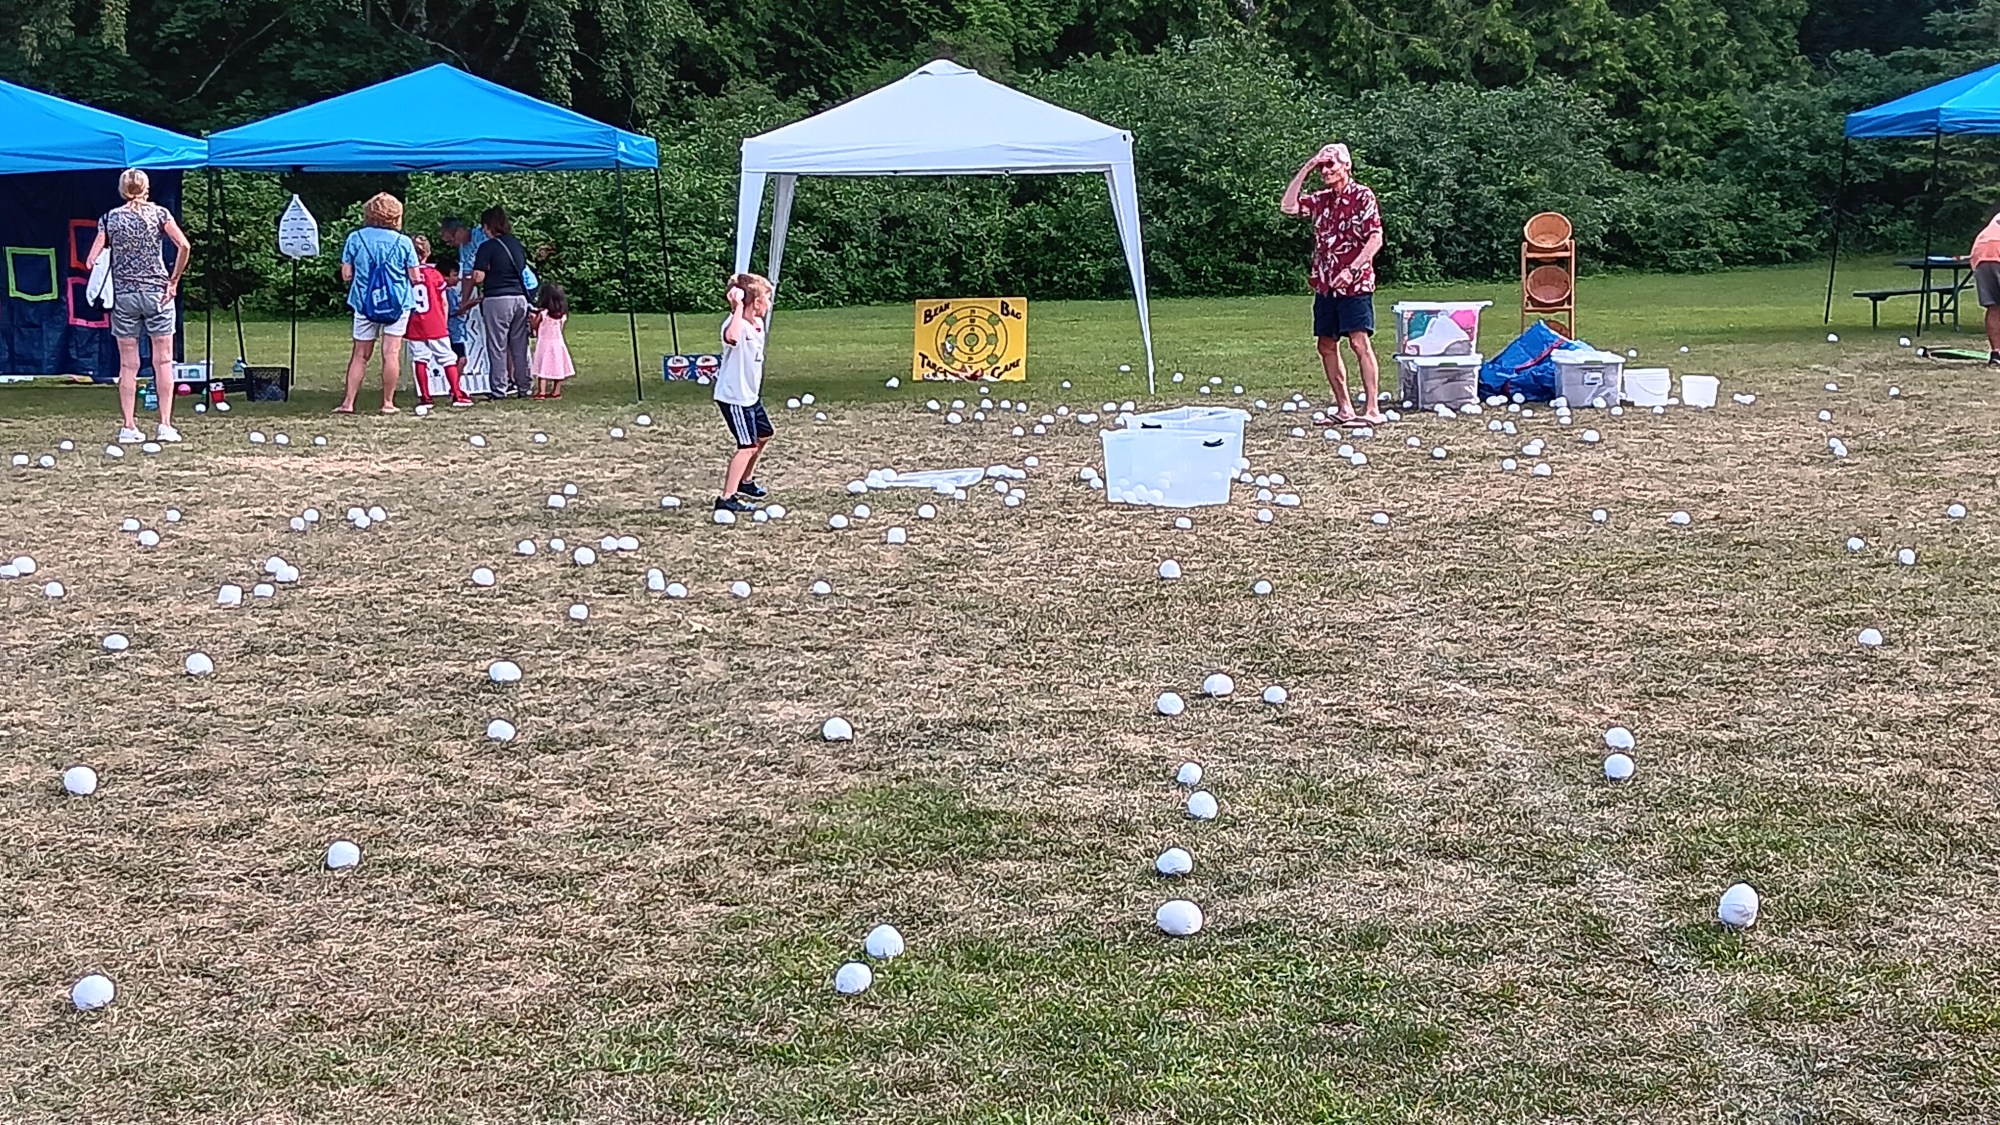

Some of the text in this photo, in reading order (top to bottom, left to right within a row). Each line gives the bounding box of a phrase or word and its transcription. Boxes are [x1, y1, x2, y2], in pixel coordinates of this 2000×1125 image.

[413, 283, 430, 314] 9
[923, 299, 1022, 325] BEAN BAG
[918, 352, 1021, 380] TARG GAME
